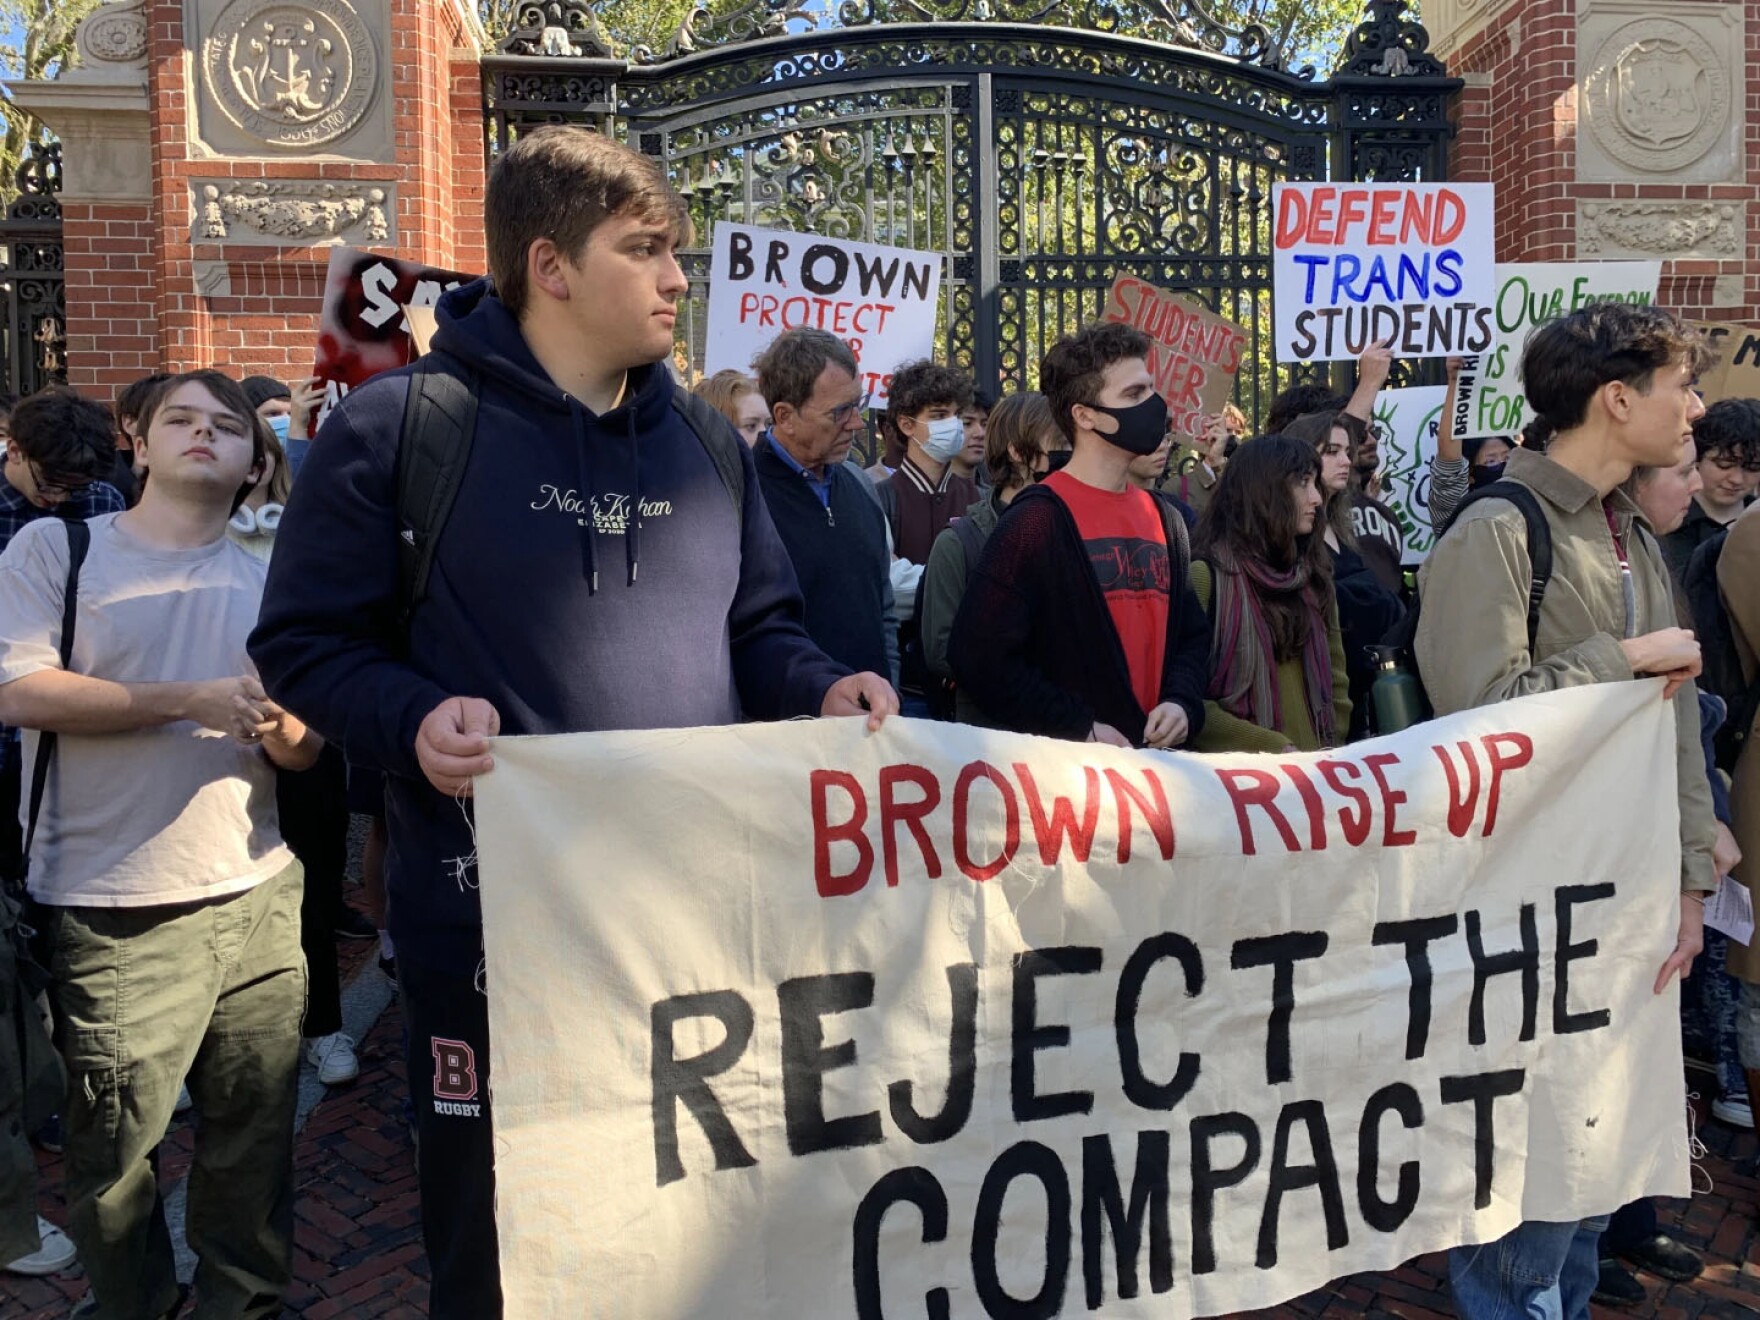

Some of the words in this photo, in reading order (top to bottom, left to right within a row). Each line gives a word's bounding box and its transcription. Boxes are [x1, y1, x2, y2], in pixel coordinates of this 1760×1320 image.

[1276, 187, 1466, 249] DEFEND
[729, 232, 931, 301] BROWN
[1293, 249, 1464, 305] TRANS
[740, 293, 895, 335] PROTECT
[1107, 279, 1245, 374] STUDENTS
[1291, 303, 1492, 359] STUDENTS
[1496, 276, 1564, 334] OUR
[1485, 344, 1509, 379] IS
[1454, 376, 1476, 436] BROWN
[1478, 386, 1525, 431] FOR
[604, 493, 673, 519] Khan
[810, 760, 1175, 897] BROWN
[1216, 752, 1417, 856] RISE
[1432, 732, 1533, 838] UP
[651, 931, 1328, 1188] REJECT
[1371, 882, 1616, 1060] THE
[431, 1036, 478, 1100] B
[433, 1100, 481, 1117] RUGBY
[852, 1068, 1525, 1320] COMPACT
